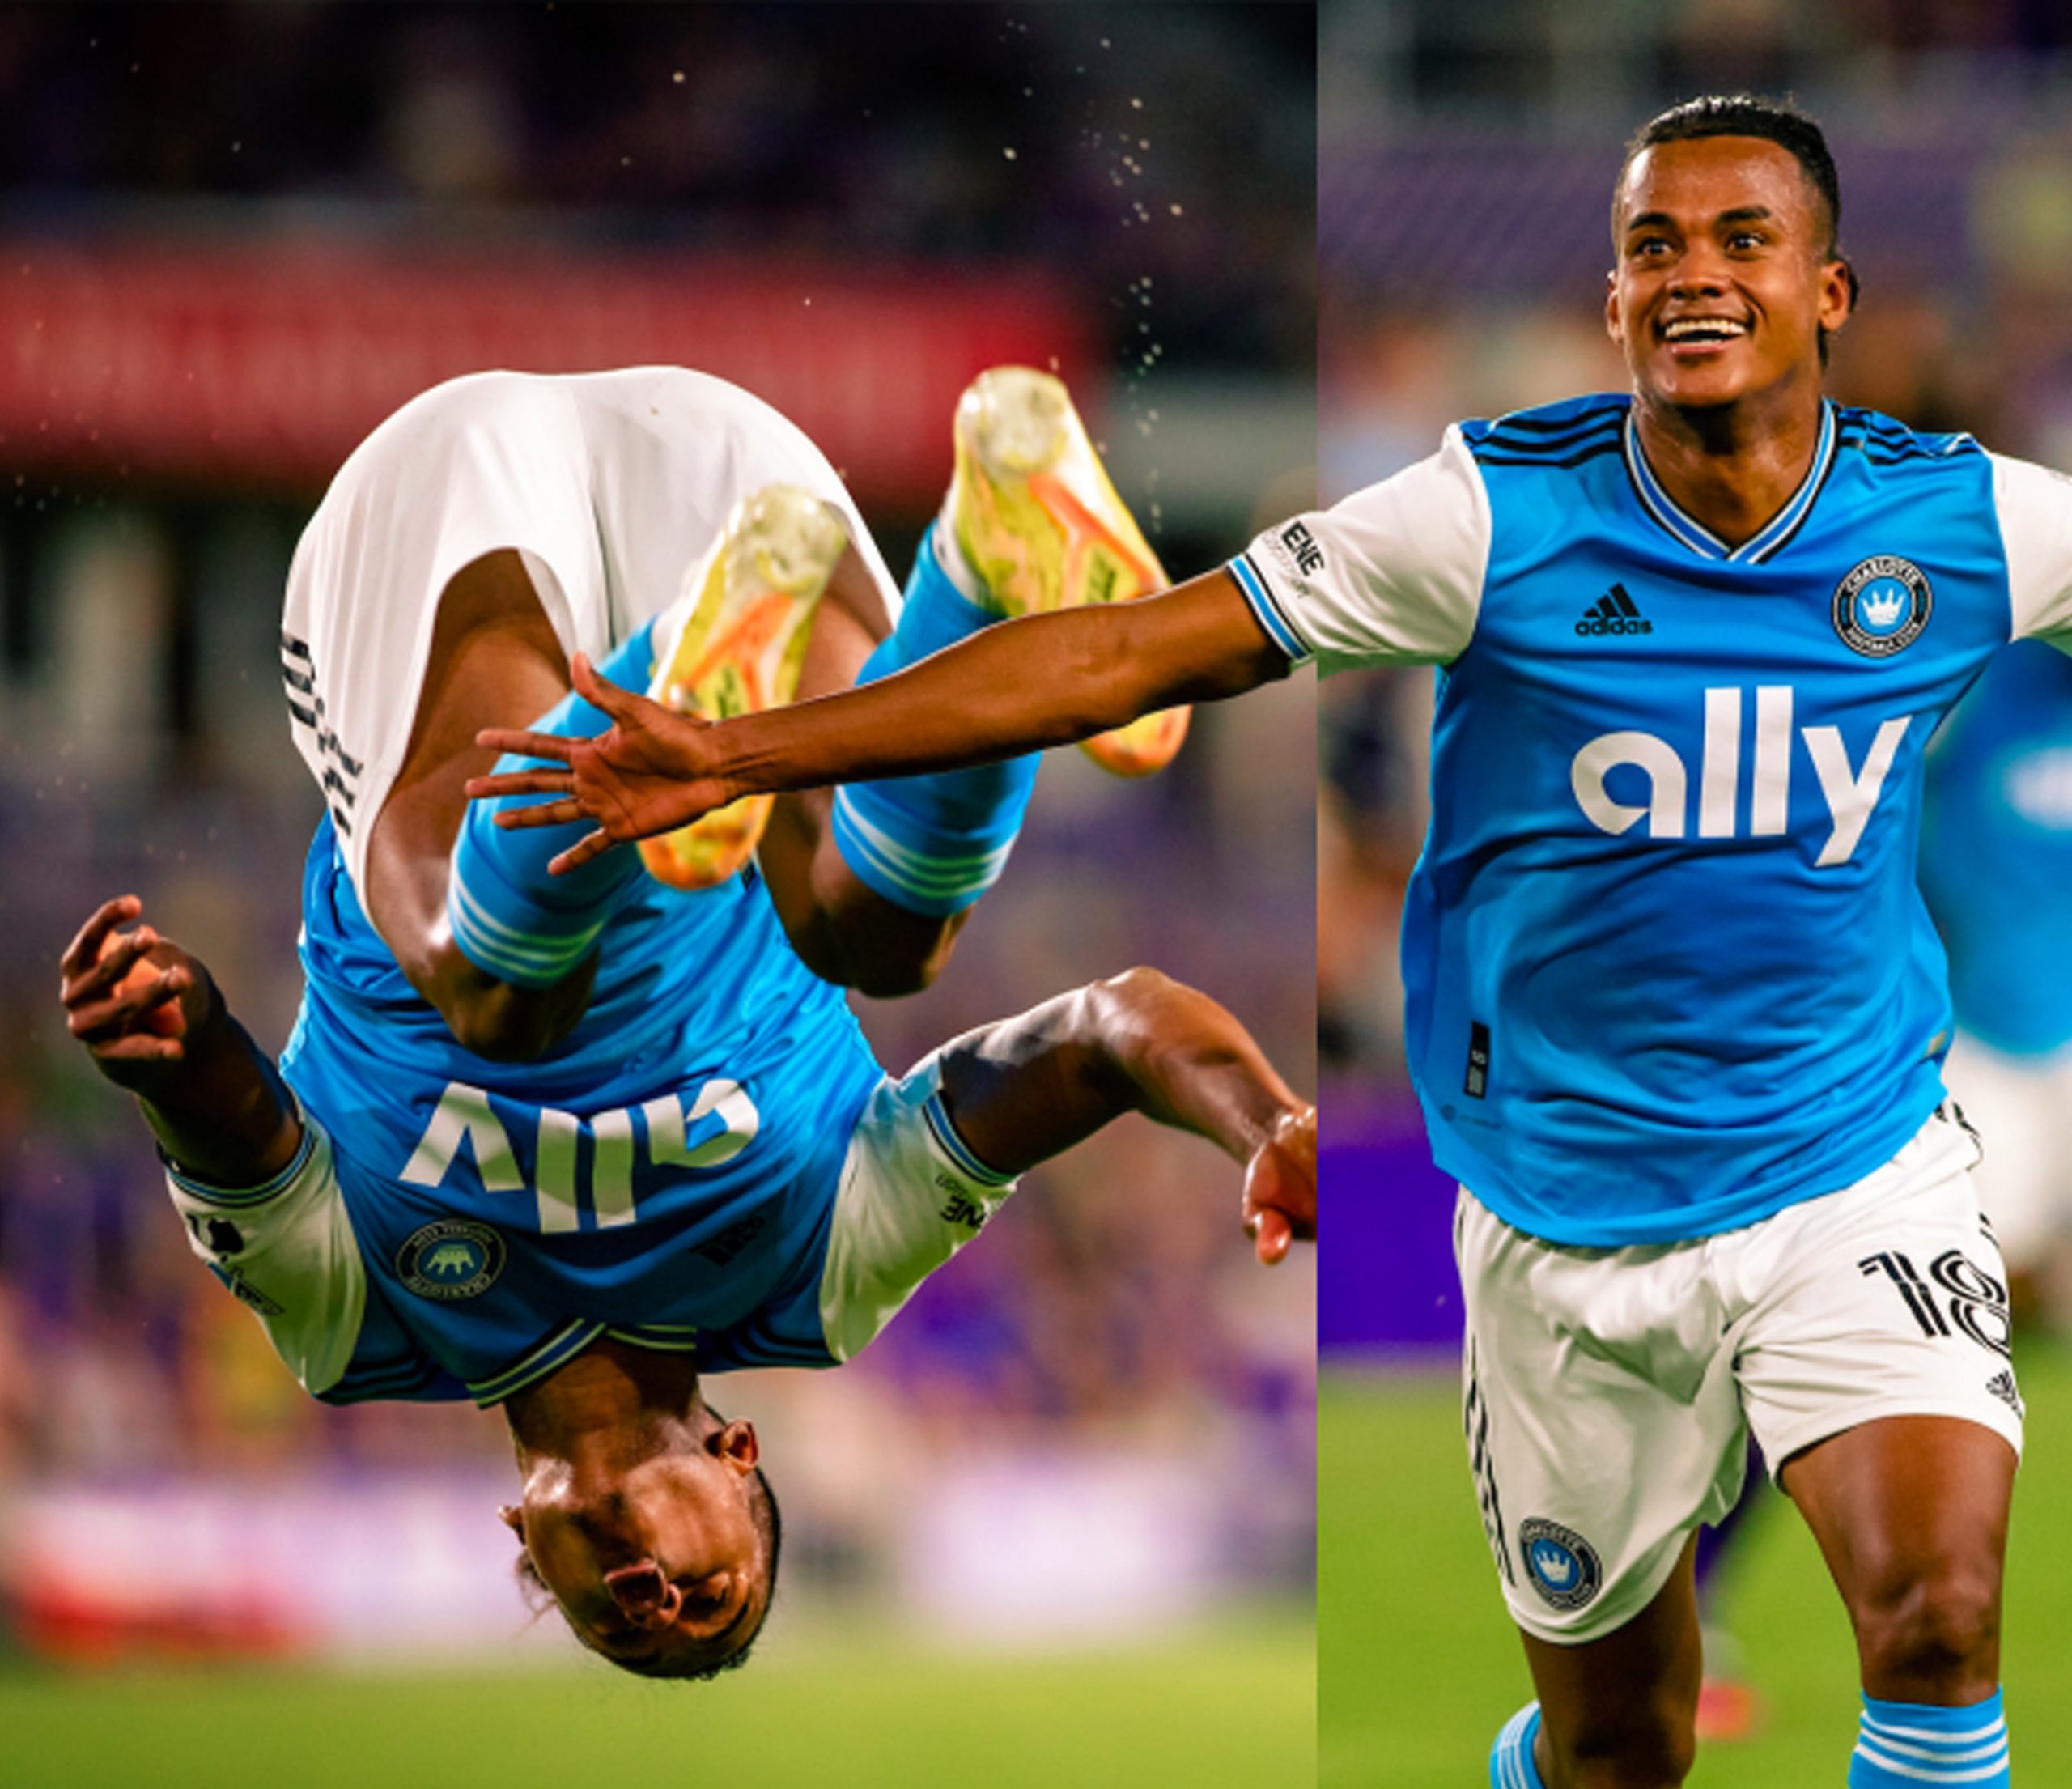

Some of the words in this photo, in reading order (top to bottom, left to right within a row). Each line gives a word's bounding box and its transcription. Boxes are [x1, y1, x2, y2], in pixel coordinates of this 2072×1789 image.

[1574, 616, 1654, 636] adidas
[1571, 686, 1913, 867] ally
[398, 1078, 759, 1234] ally
[1858, 1249, 2012, 1362] 18
